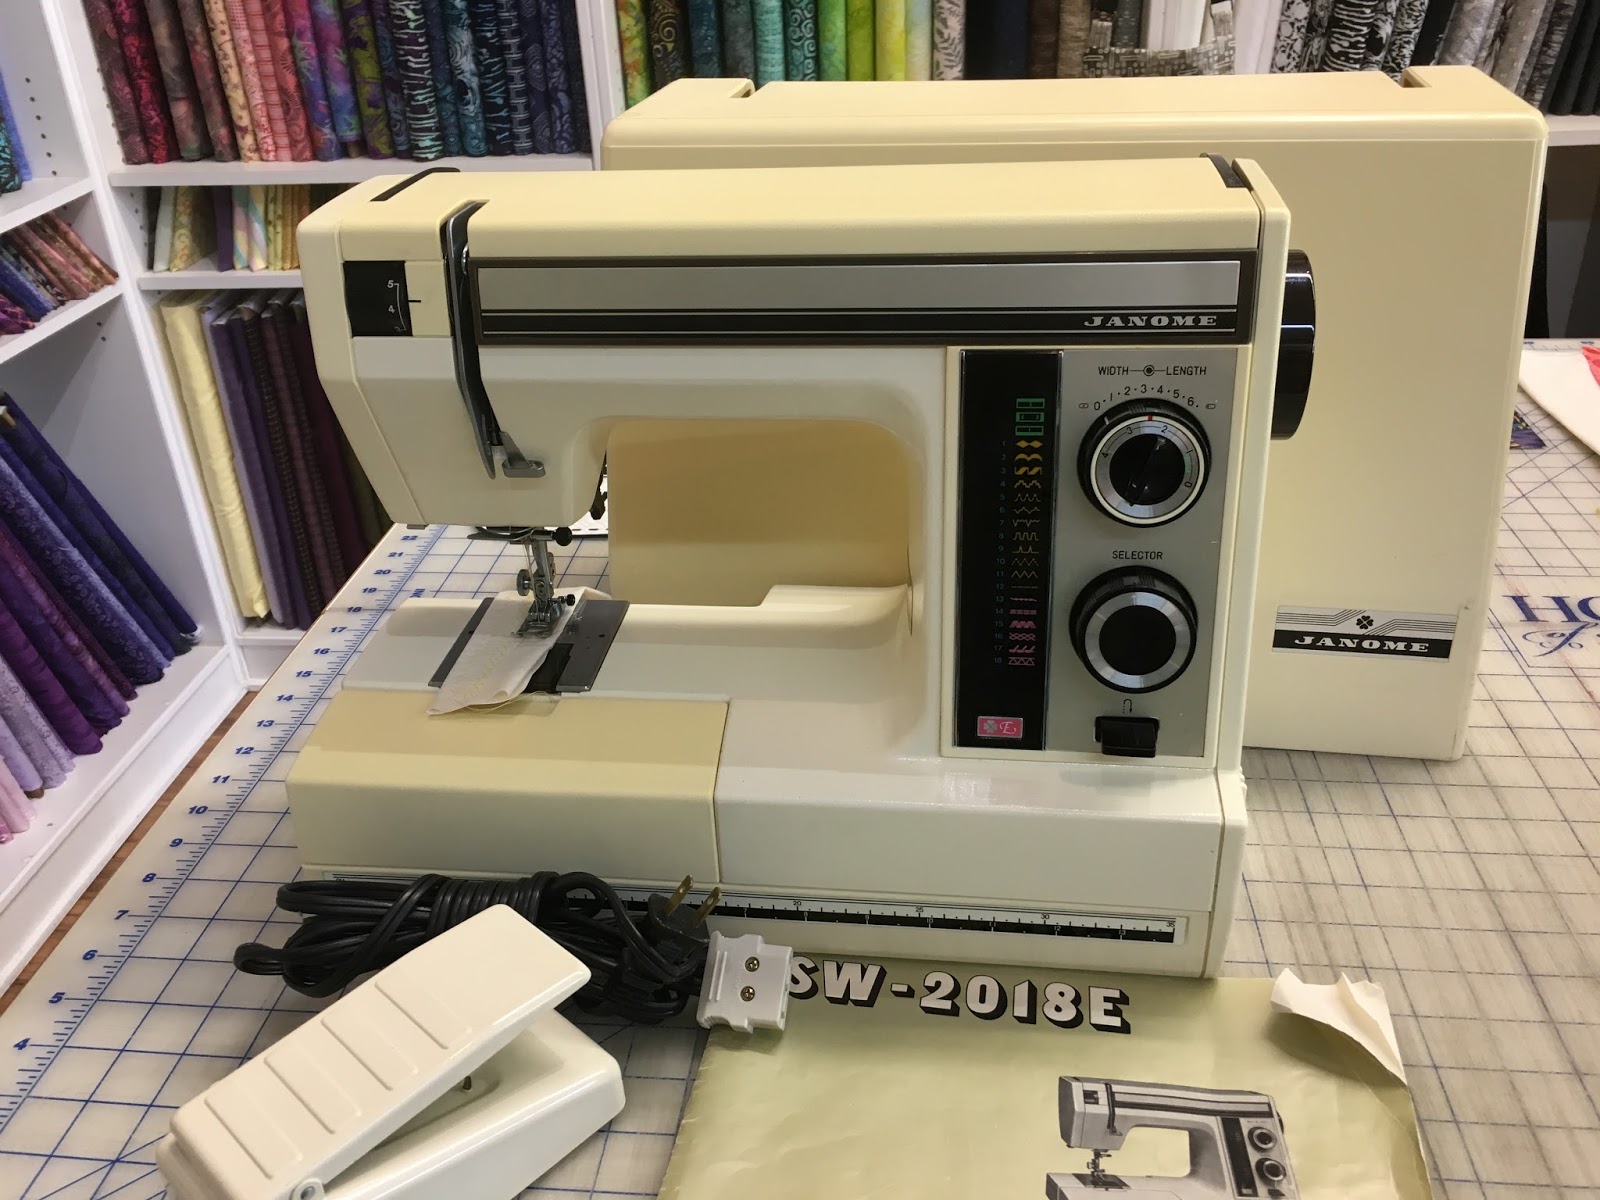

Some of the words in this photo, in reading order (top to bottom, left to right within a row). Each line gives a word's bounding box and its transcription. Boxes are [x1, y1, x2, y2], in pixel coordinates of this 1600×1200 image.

[387, 279, 394, 288] 5
[388, 304, 395, 314] 4
[1084, 315, 1217, 327] JANOME
[1098, 366, 1129, 376] WIDTH
[1166, 366, 1207, 376] LENGTH
[1093, 401, 1101, 410] 0
[1124, 386, 1131, 396] 2
[1140, 384, 1147, 393] 3
[1157, 385, 1163, 394] 4
[1173, 389, 1180, 398] 5
[1187, 397, 1194, 406] 6
[1126, 427, 1133, 435] 3
[1160, 424, 1168, 434] 2
[1112, 550, 1163, 560] SELECTOR
[1294, 635, 1430, 653] JANOME
[276, 694, 294, 702] 14
[256, 719, 275, 728] 13
[999, 721, 1017, 735] E
[235, 746, 255, 755] 12
[212, 775, 231, 784] 11
[188, 805, 209, 815] 10
[169, 838, 183, 847] 9
[142, 873, 157, 882] 8
[114, 910, 129, 920] 7
[82, 950, 98, 960] 6
[48, 992, 65, 1004] 5
[789, 956, 1131, 1034] SW-2018E
[13, 1037, 31, 1050] 4
